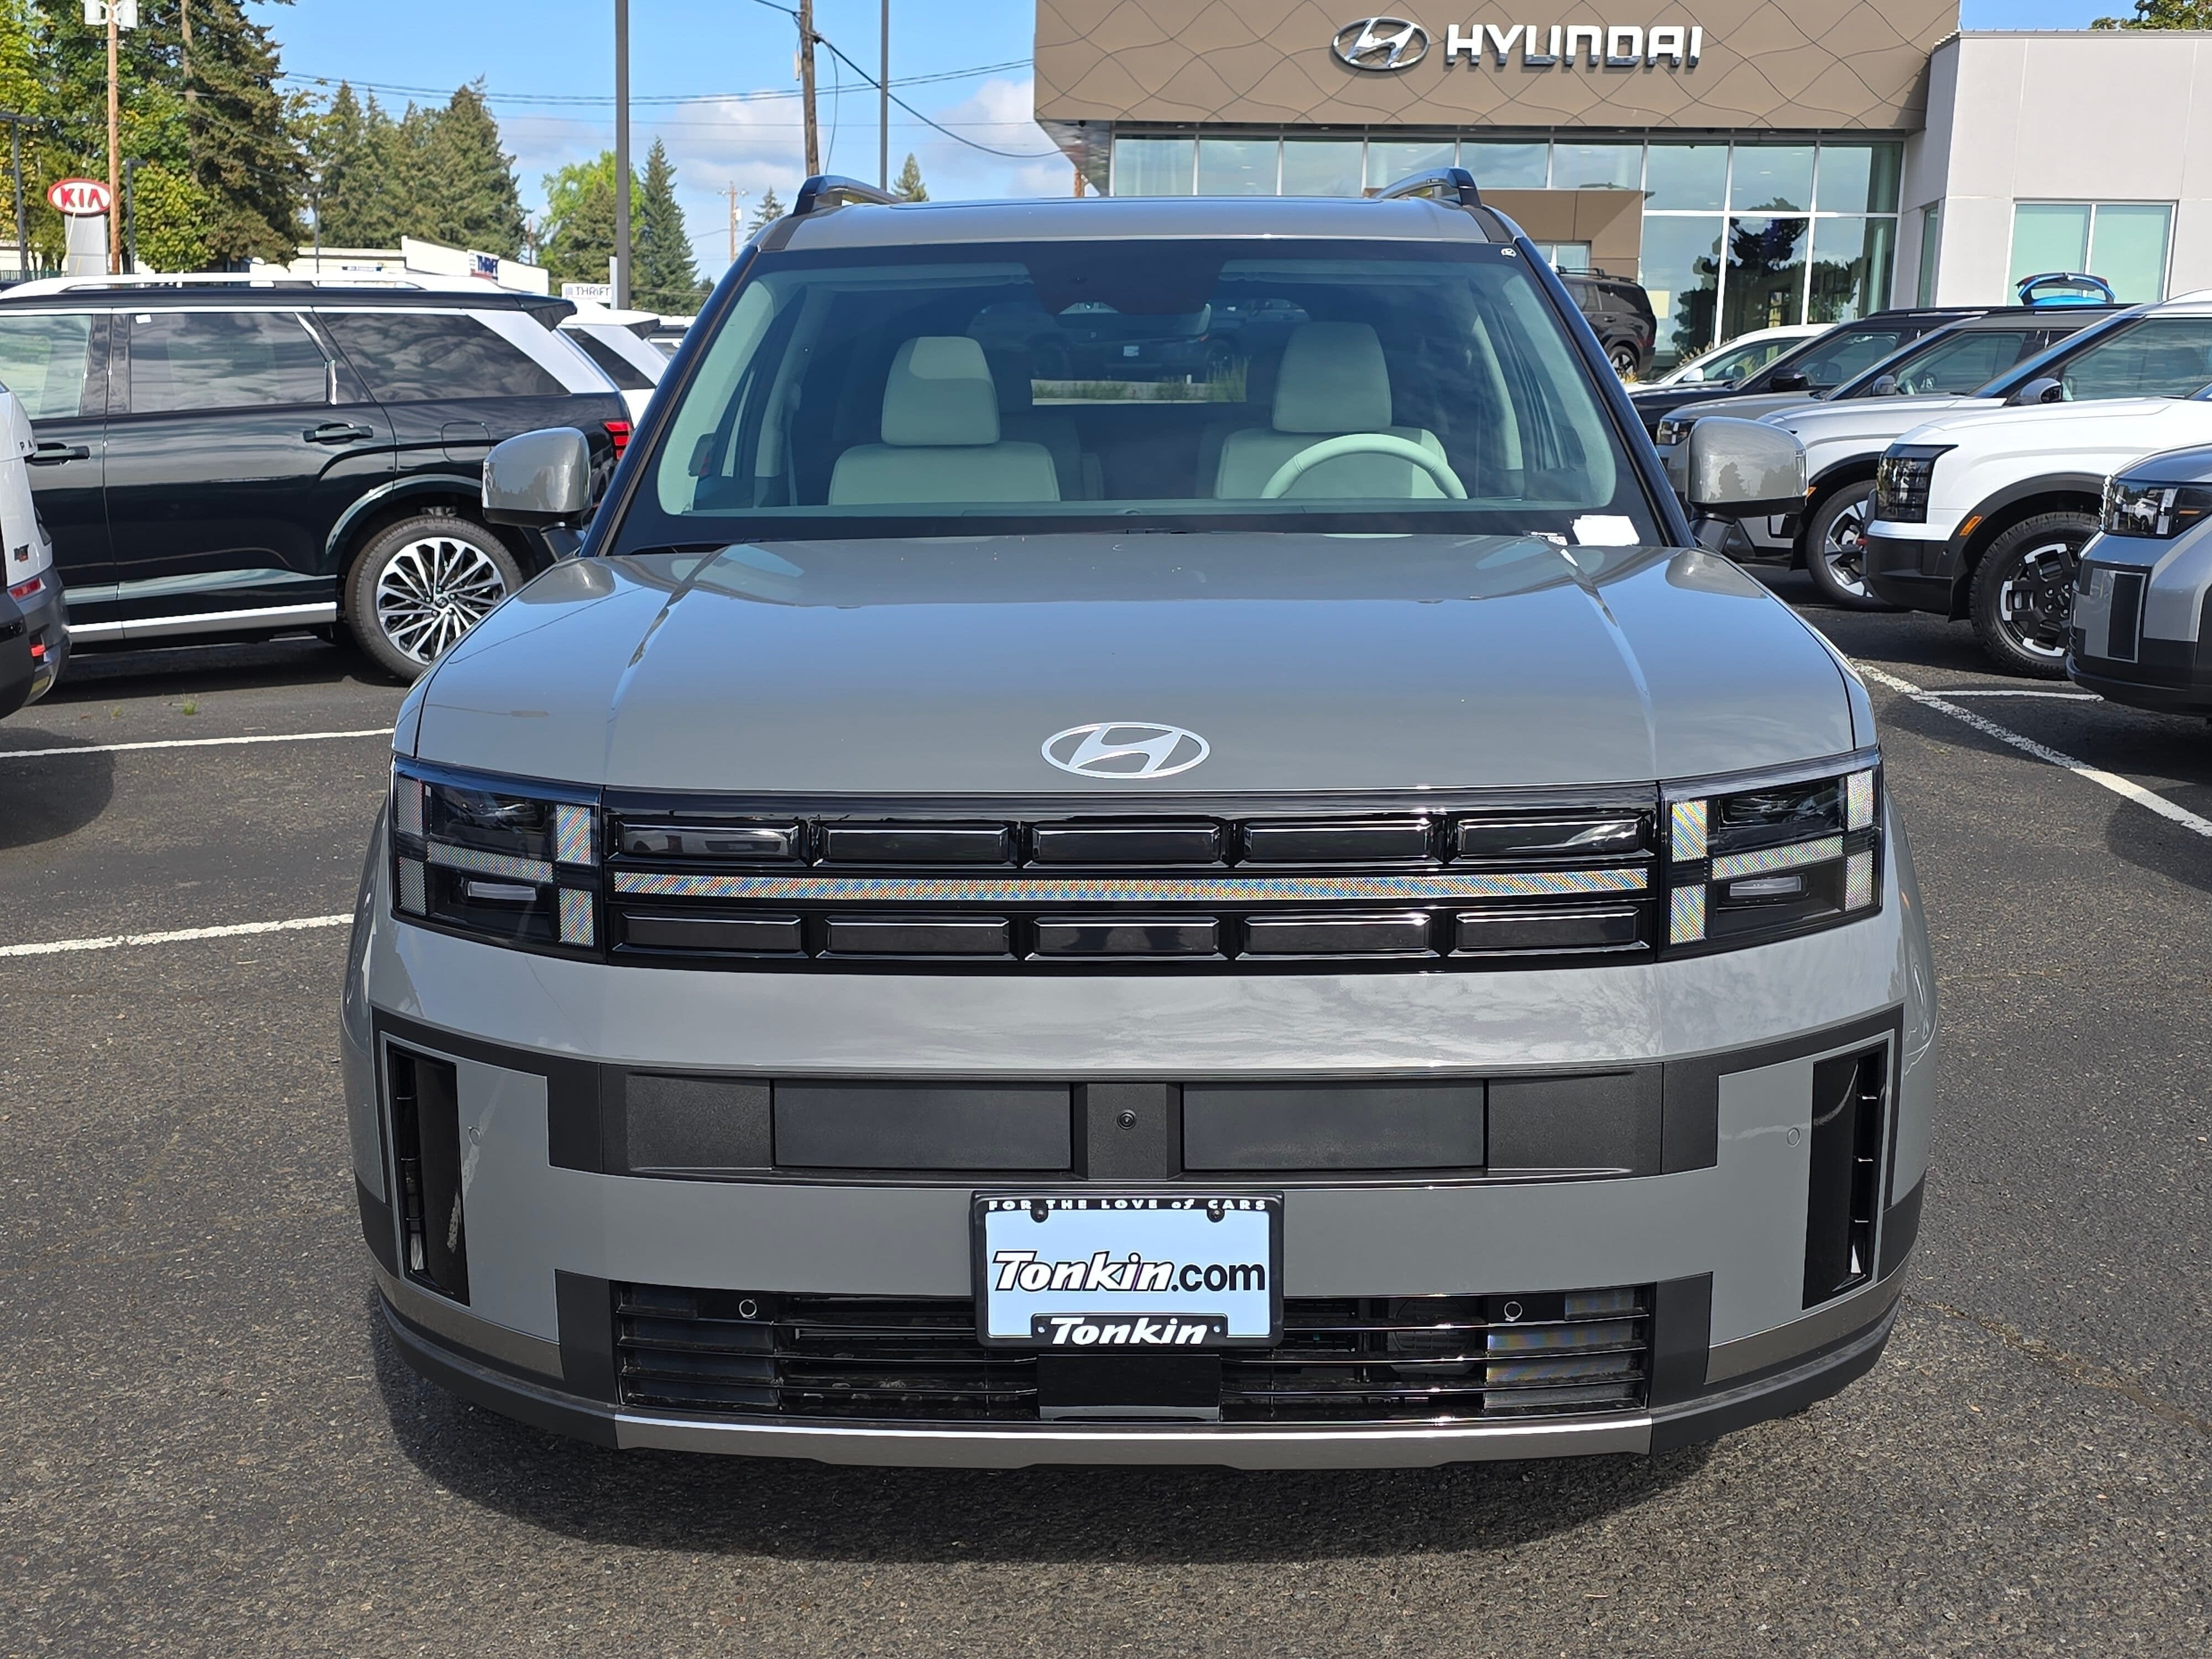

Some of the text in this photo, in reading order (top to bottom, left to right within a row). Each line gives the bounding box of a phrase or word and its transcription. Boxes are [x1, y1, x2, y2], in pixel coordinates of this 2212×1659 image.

[1445, 24, 1703, 66] HYUNDAI
[60, 187, 105, 208] KIA
[575, 286, 611, 295] THRIFT
[988, 1199, 1266, 1211] FOR THE LOVE of CARS
[993, 1250, 1266, 1292] Tonkin.com
[1050, 1316, 1208, 1345] Tonkin
